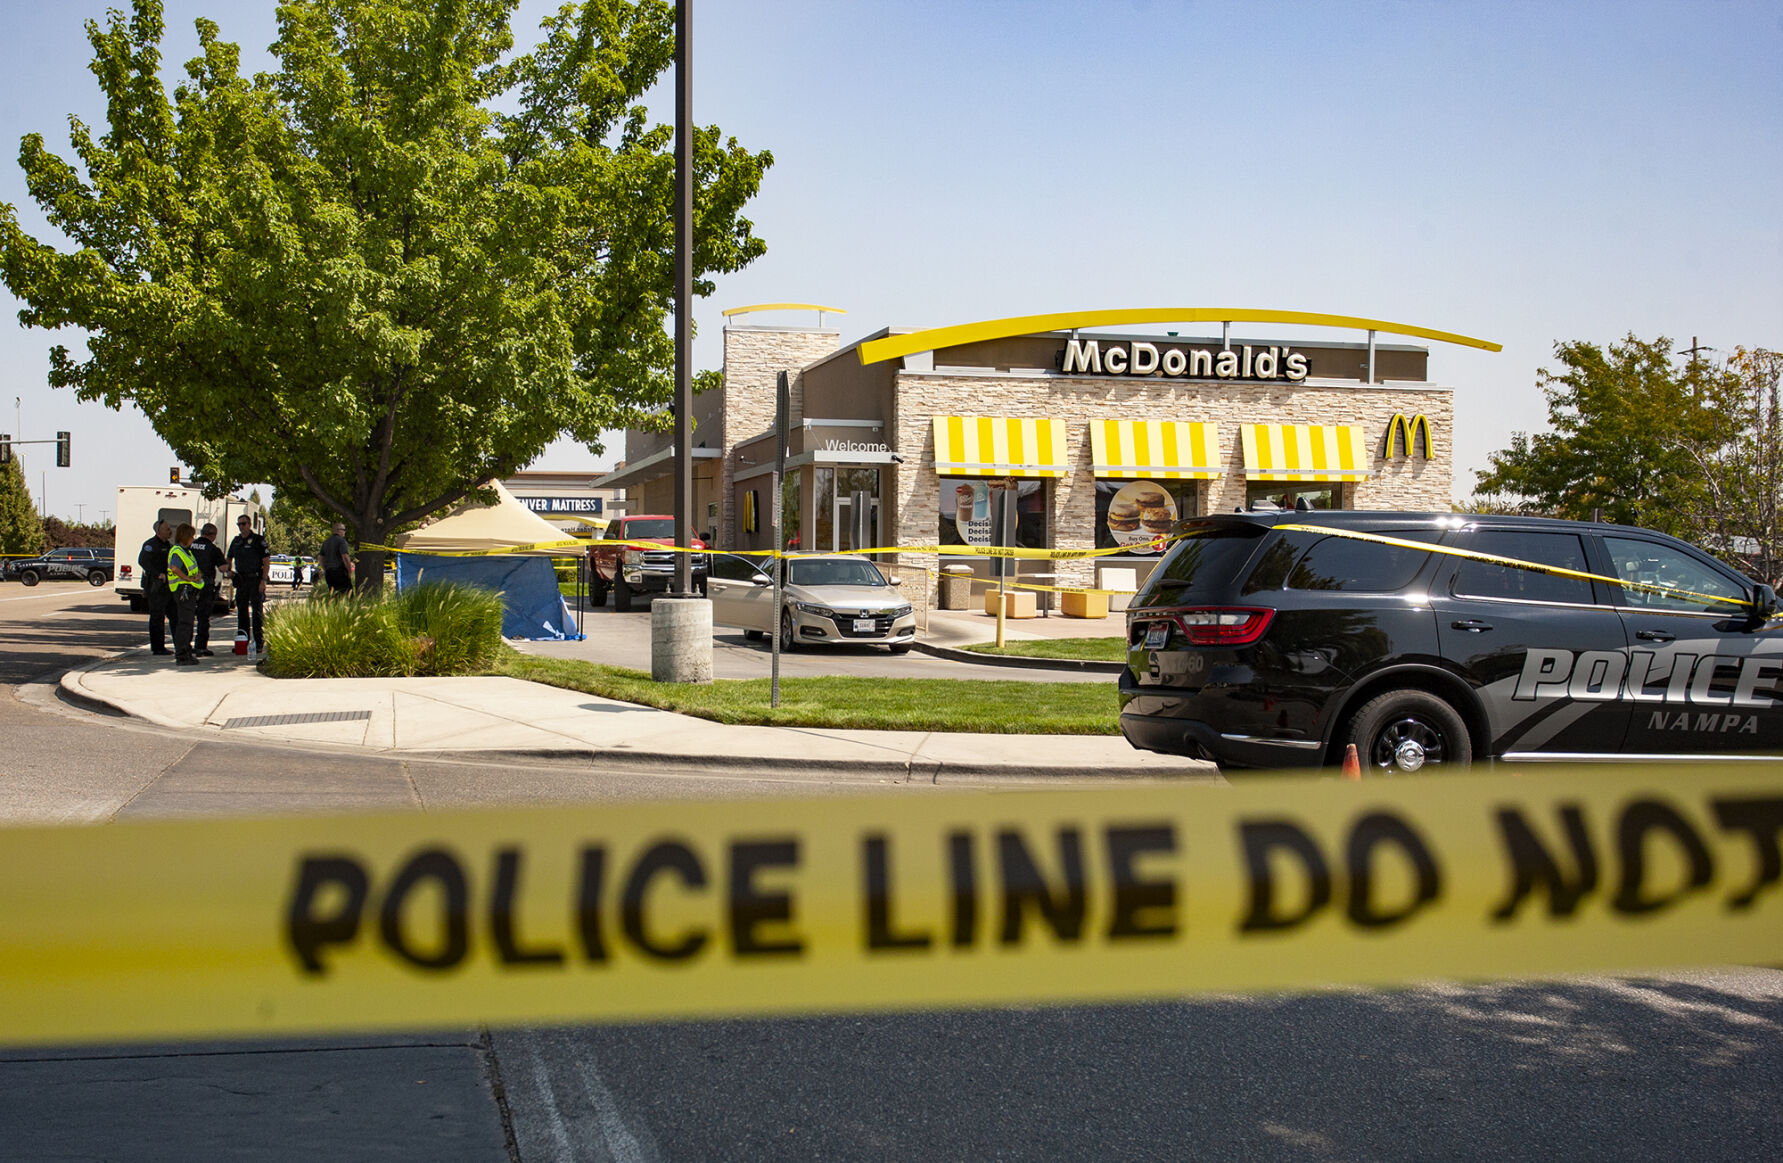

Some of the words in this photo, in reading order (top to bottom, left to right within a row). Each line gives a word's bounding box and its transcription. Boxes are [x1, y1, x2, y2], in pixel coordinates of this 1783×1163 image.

[1061, 339, 1310, 381] McDonald's
[825, 439, 887, 453] Welcome
[551, 498, 597, 512] MATTRESS
[190, 542, 206, 551] POLICE
[271, 571, 293, 579] POLI
[1511, 647, 1783, 709] POLICE
[1647, 711, 1759, 735] NAMPA
[284, 834, 812, 978] POLICE
[856, 820, 1184, 955] LINE
[1232, 807, 1444, 938] DO
[1487, 794, 1783, 926] NOT
